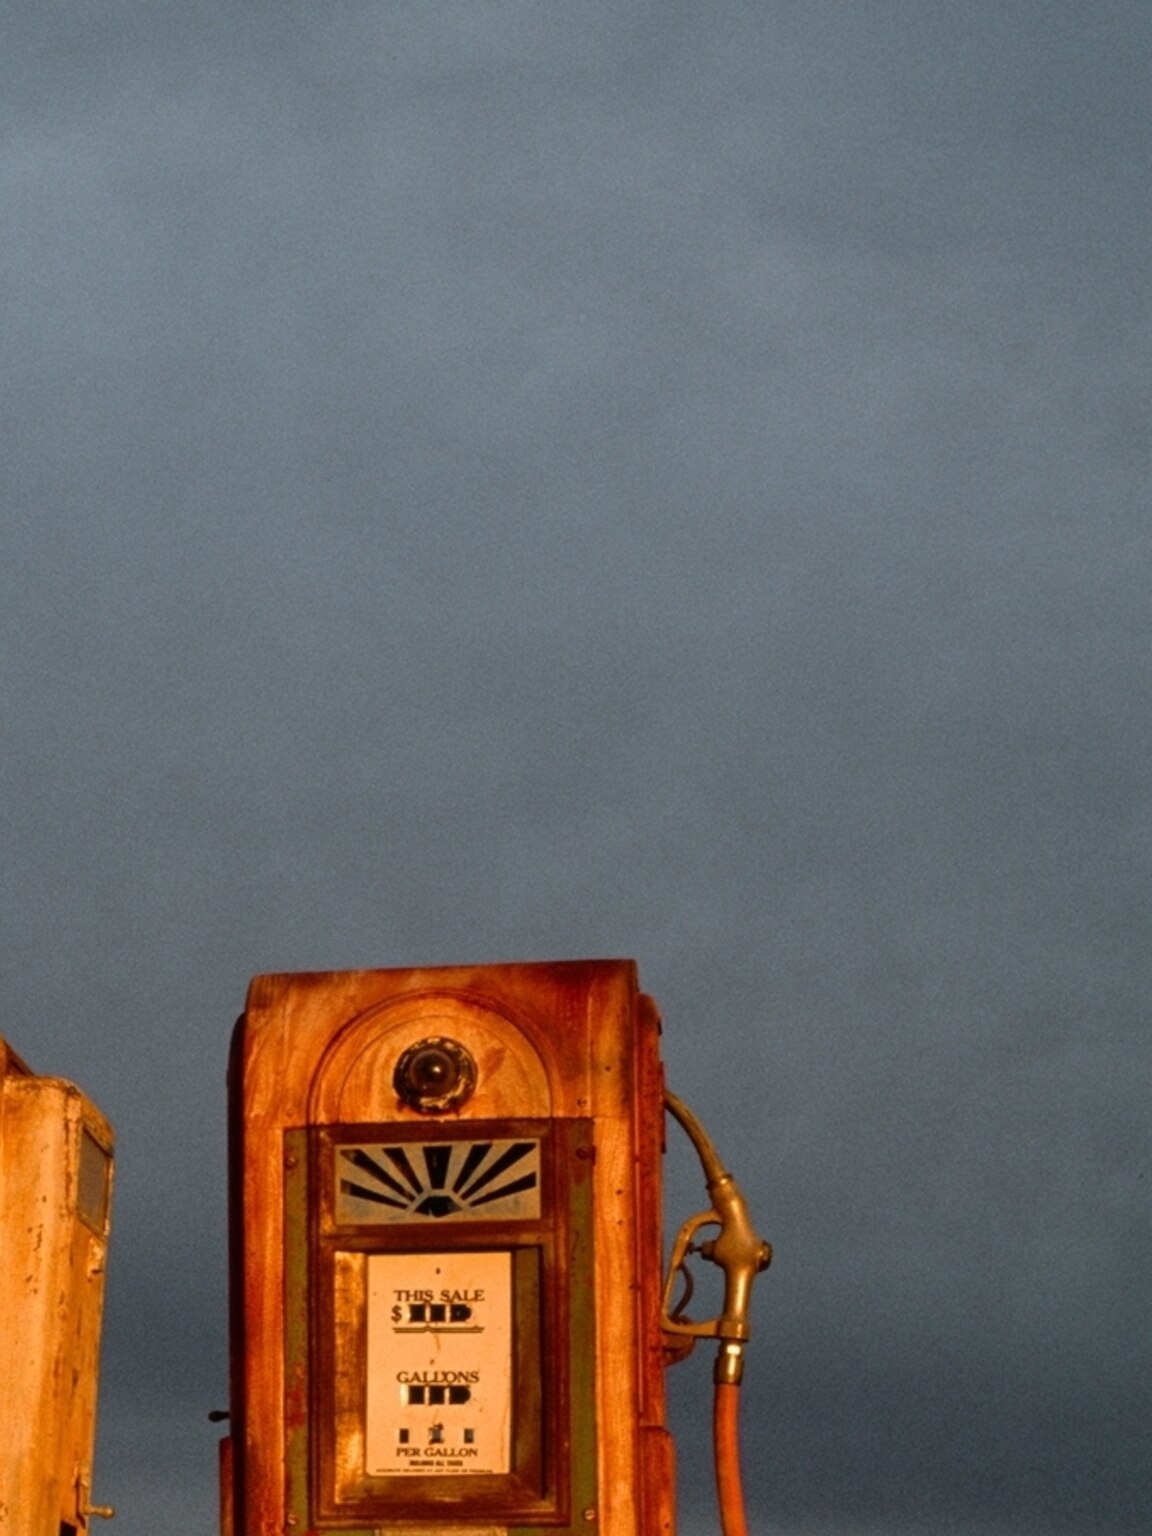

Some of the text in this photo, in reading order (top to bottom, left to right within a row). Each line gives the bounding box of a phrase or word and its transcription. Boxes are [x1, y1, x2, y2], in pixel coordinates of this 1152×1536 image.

[394, 1289, 485, 1301] THIS SALE
[391, 1304, 403, 1323] $
[396, 1371, 480, 1384] GALLONS
[396, 1447, 479, 1457] PER GALLON
